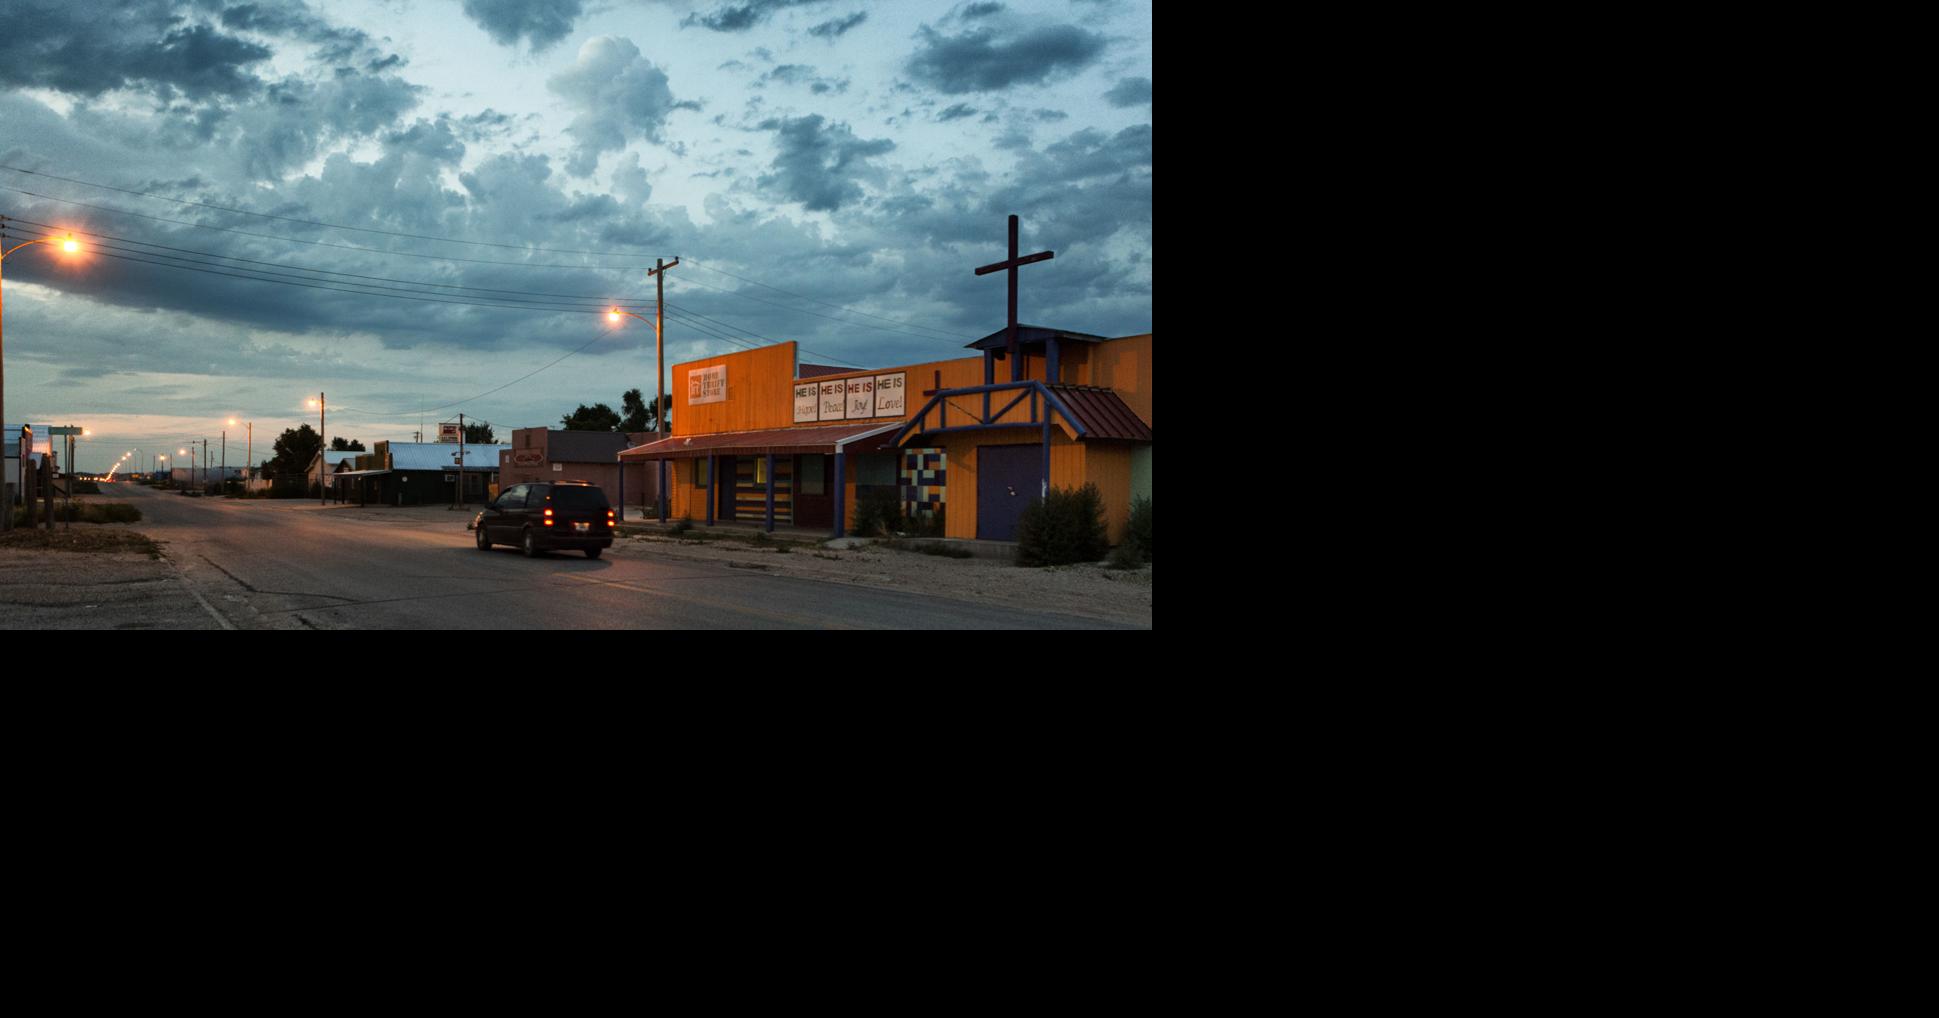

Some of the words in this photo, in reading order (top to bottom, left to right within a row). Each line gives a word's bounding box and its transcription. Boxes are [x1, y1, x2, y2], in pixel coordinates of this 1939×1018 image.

[821, 385, 833, 396] HE
[834, 383, 844, 394] IS
[848, 383, 859, 394] HE
[863, 382, 873, 393] IS
[877, 378, 891, 390] HE
[893, 377, 903, 388] IS
[703, 388, 721, 398] STORE
[796, 388, 807, 398] HE
[808, 387, 817, 397] IS
[877, 396, 903, 410] Love!
